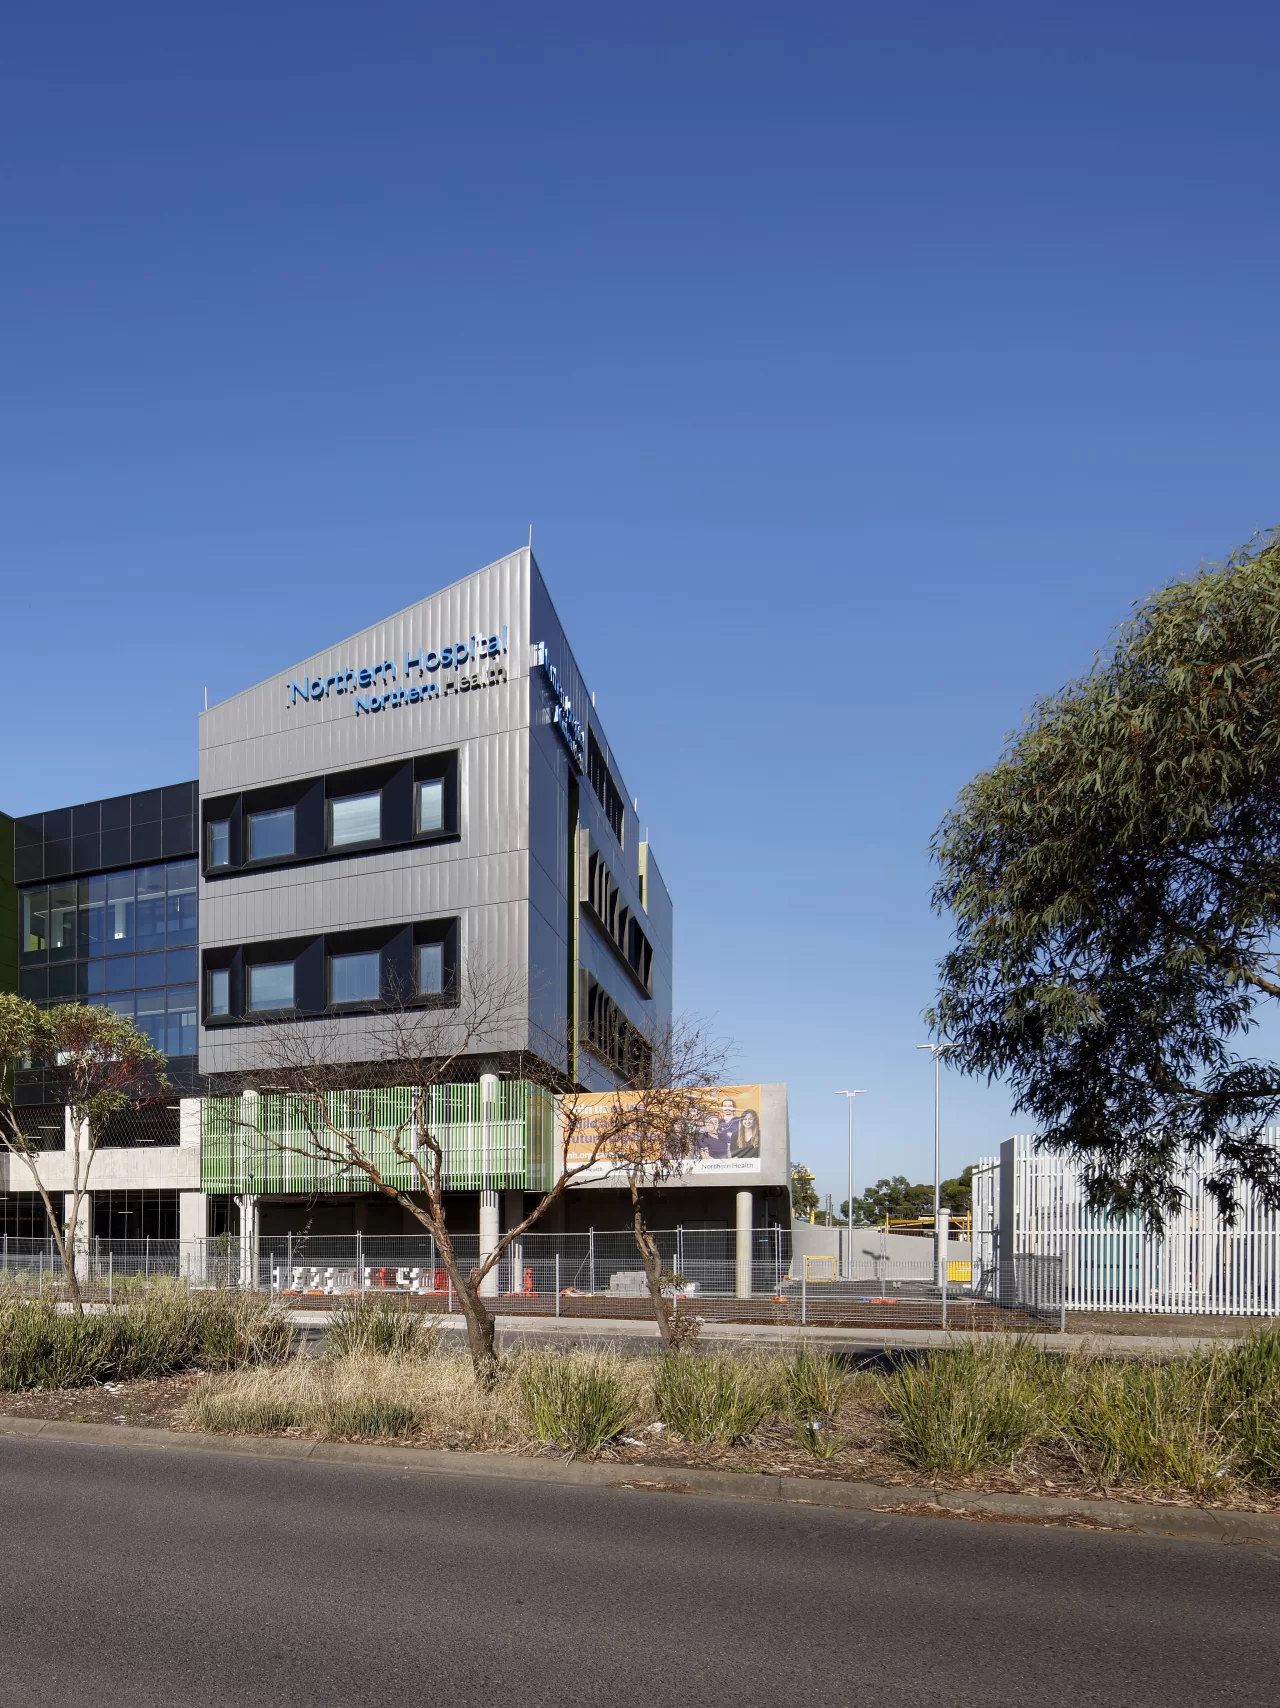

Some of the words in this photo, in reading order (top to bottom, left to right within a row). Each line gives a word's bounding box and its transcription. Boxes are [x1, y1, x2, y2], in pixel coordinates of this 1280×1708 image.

[291, 660, 396, 703] Northern
[405, 624, 507, 675] Hospital
[355, 682, 439, 714] Northern
[442, 663, 507, 696] Health
[595, 1105, 609, 1114] us
